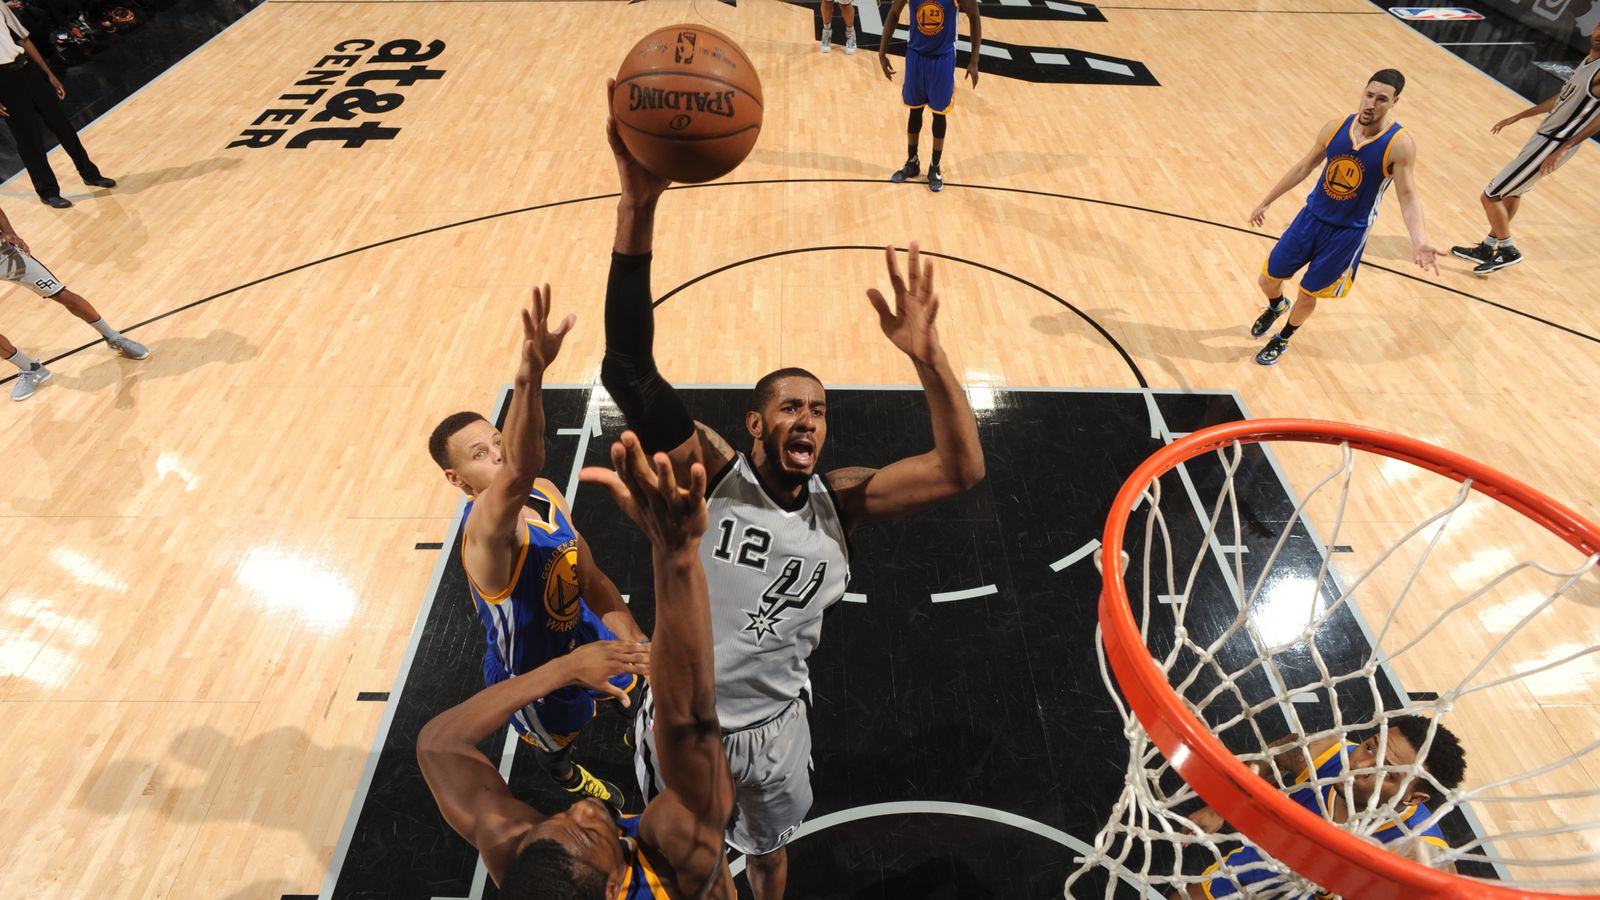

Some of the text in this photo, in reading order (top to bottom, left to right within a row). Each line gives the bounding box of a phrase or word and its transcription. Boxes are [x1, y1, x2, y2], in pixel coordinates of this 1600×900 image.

[929, 9, 940, 17] 23
[225, 38, 375, 149] CENTER
[628, 82, 735, 118] SPALDING
[1345, 167, 1355, 178] 11
[541, 542, 568, 580] GOLDEN
[712, 517, 774, 572] 12
